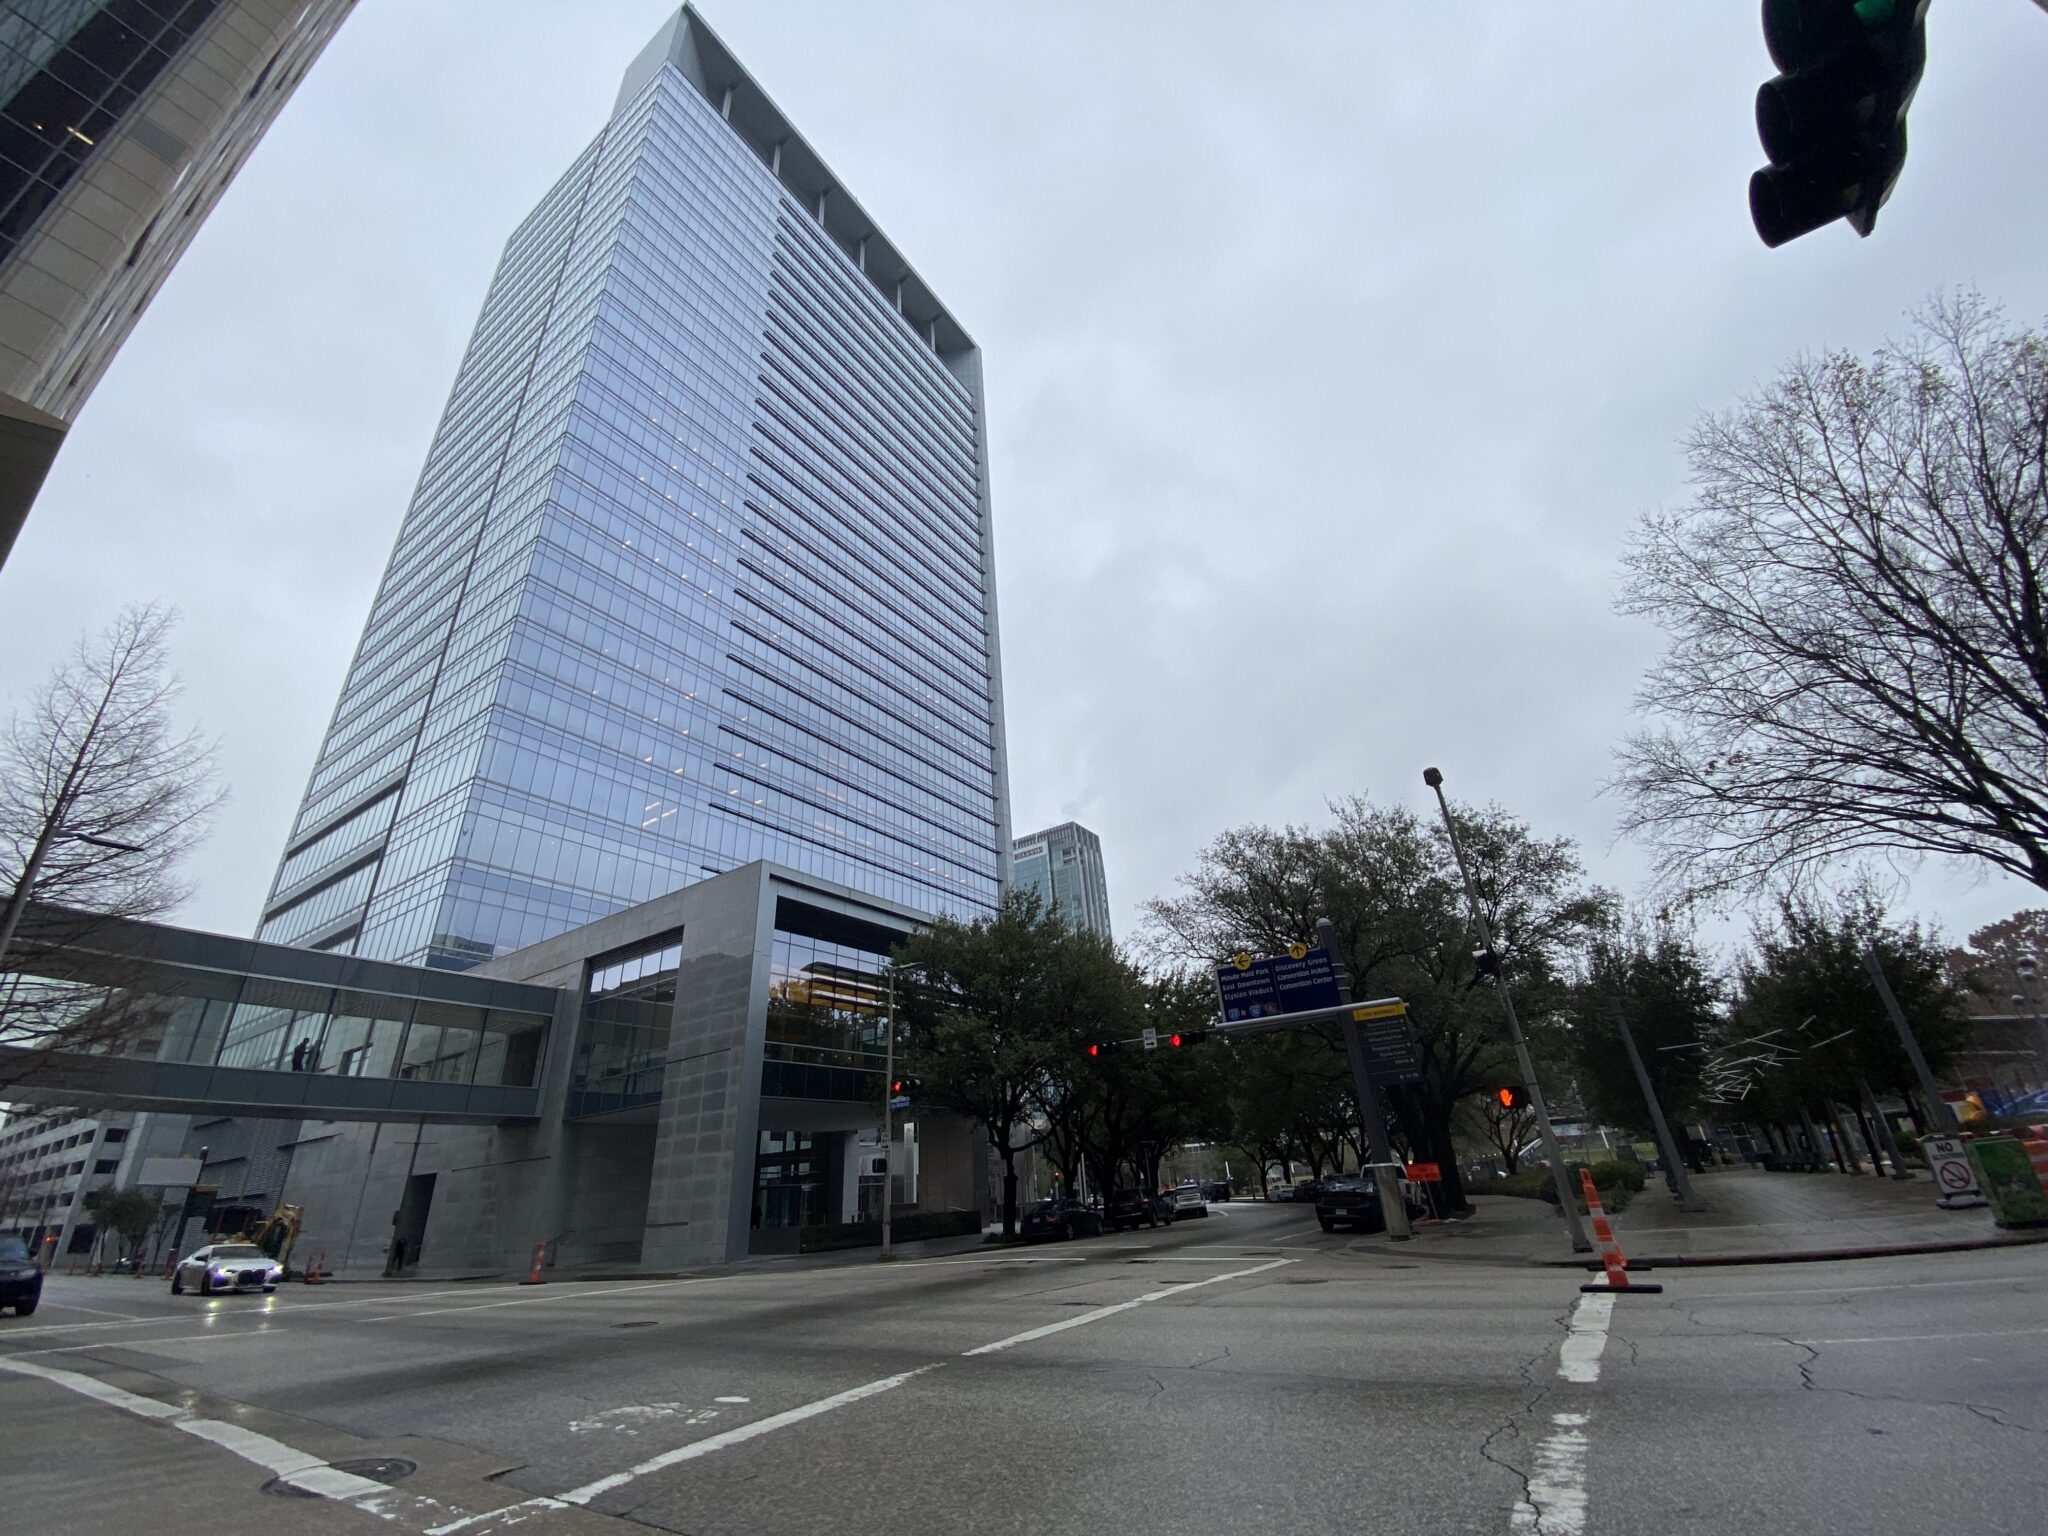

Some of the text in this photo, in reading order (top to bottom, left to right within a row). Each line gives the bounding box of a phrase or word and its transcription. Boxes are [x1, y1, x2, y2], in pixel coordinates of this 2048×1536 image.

[1275, 957, 1328, 972] Discovery Green
[1221, 973, 1240, 982] Minute
[1256, 967, 1269, 976] Park
[1278, 966, 1330, 981] Convention Hotels
[1222, 977, 1270, 991] East Downtown
[1280, 975, 1333, 990] Convention Center
[1224, 990, 1247, 1001] Elysian
[1935, 1142, 1953, 1153] NO
